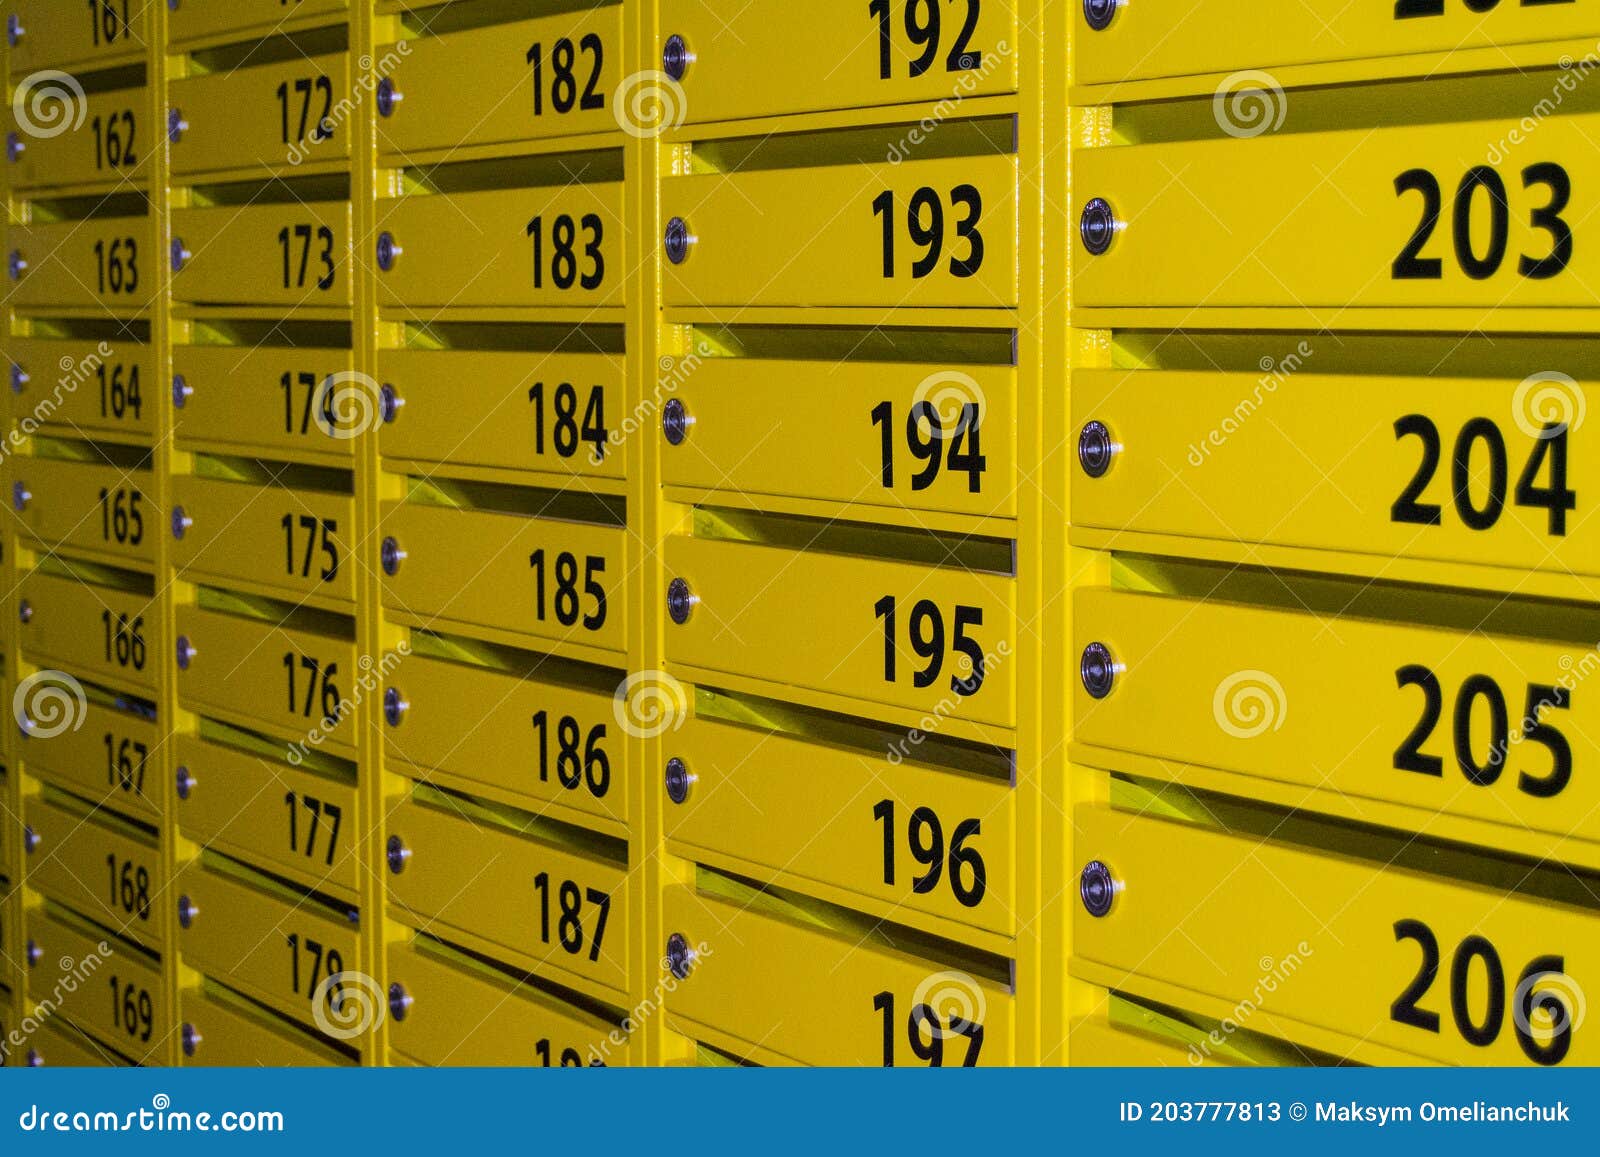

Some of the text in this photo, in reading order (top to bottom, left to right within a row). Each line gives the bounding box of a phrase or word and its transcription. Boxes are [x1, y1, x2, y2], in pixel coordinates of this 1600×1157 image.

[88, 0, 129, 46] 161
[869, 0, 982, 80] 192
[276, 75, 334, 144] 172
[526, 33, 605, 116] 182
[92, 109, 137, 169] 162
[278, 224, 335, 291] 173
[526, 213, 605, 291] 183
[872, 184, 984, 279] 193
[1392, 161, 1573, 280] 203
[94, 237, 138, 294] 163
[96, 364, 142, 419] 164
[280, 371, 339, 438] 174
[528, 382, 608, 461] 184
[871, 400, 986, 493] 194
[1391, 414, 1576, 537] 204
[99, 488, 143, 546] 165
[281, 513, 339, 583] 175
[529, 548, 607, 631] 185
[102, 609, 146, 671] 166
[874, 595, 985, 697] 195
[283, 652, 340, 723] 176
[104, 733, 148, 796] 167
[532, 710, 611, 798] 186
[1393, 664, 1573, 798] 205
[285, 791, 342, 866] 177
[873, 799, 986, 908] 196
[107, 853, 150, 921] 168
[534, 872, 611, 962] 187
[109, 975, 153, 1043] 169
[287, 933, 345, 1012] 178
[1391, 919, 1572, 1066] 206
